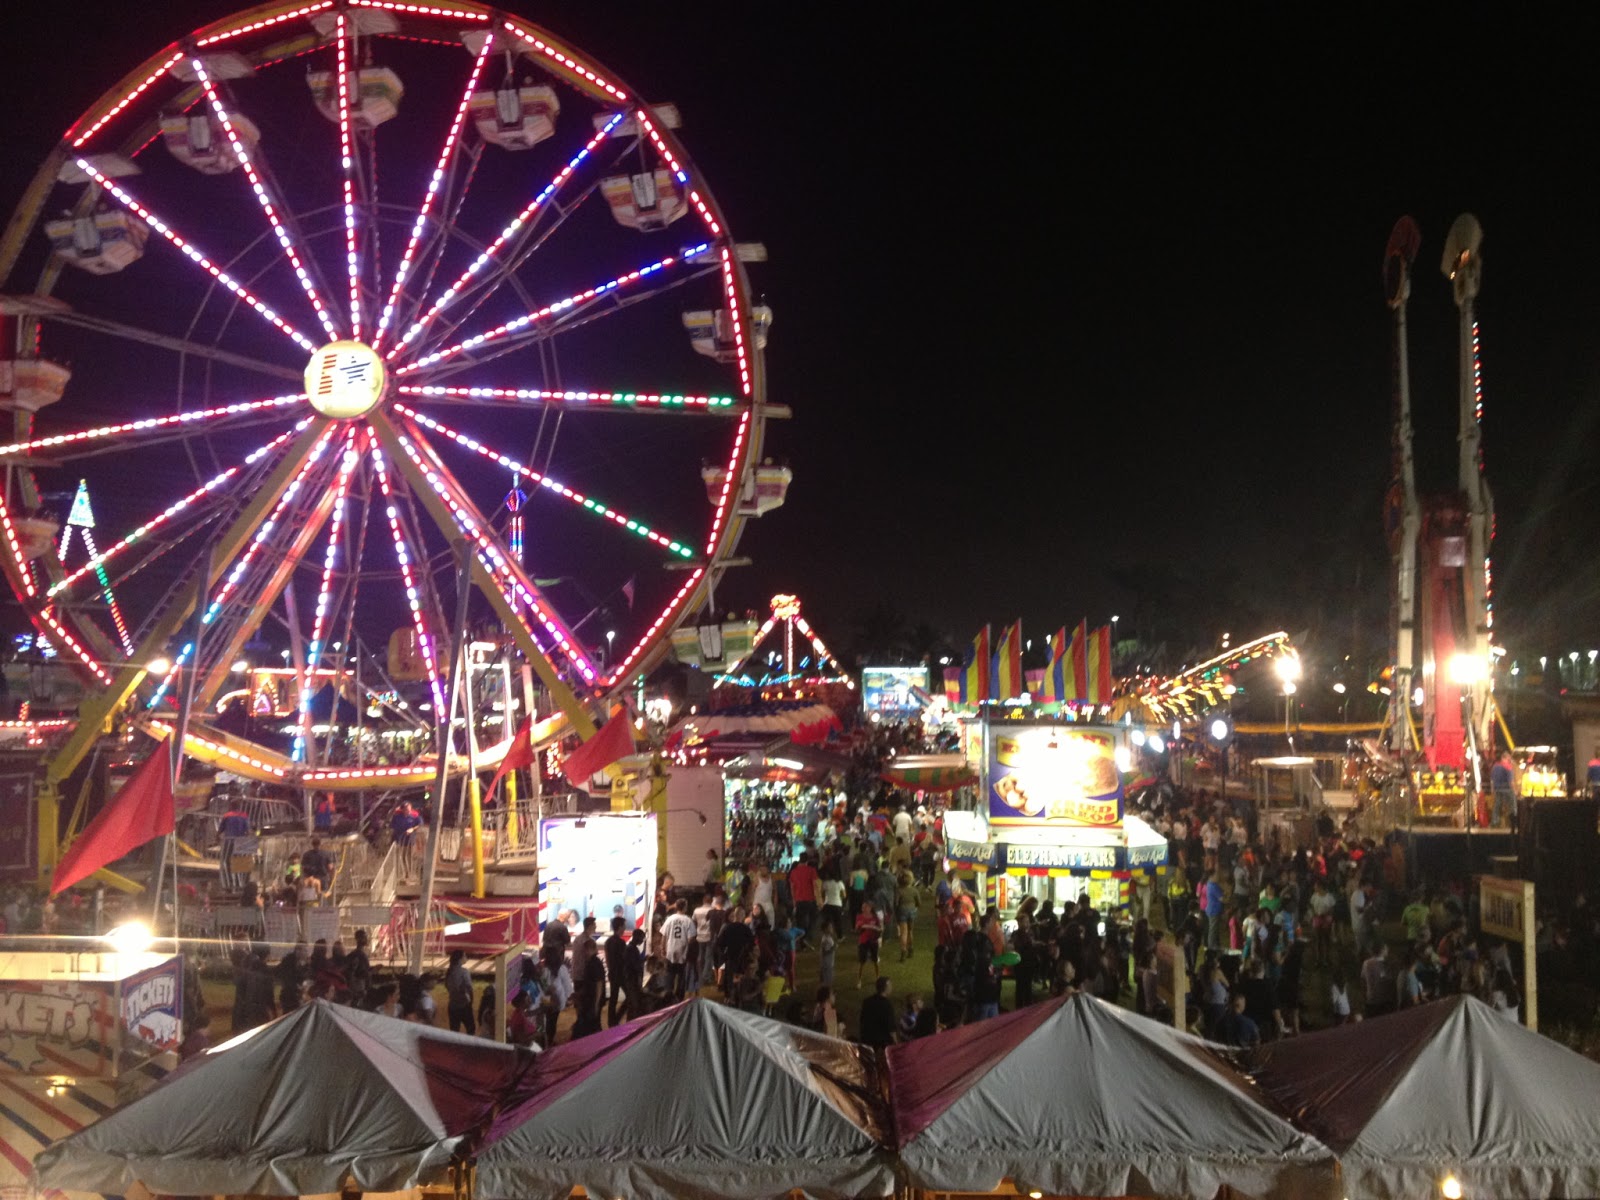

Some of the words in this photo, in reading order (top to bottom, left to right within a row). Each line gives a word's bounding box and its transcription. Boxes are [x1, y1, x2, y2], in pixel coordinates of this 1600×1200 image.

[1007, 845, 1081, 867] ELEPHANT
[1083, 848, 1116, 868] EARS
[674, 926, 682, 939] 2
